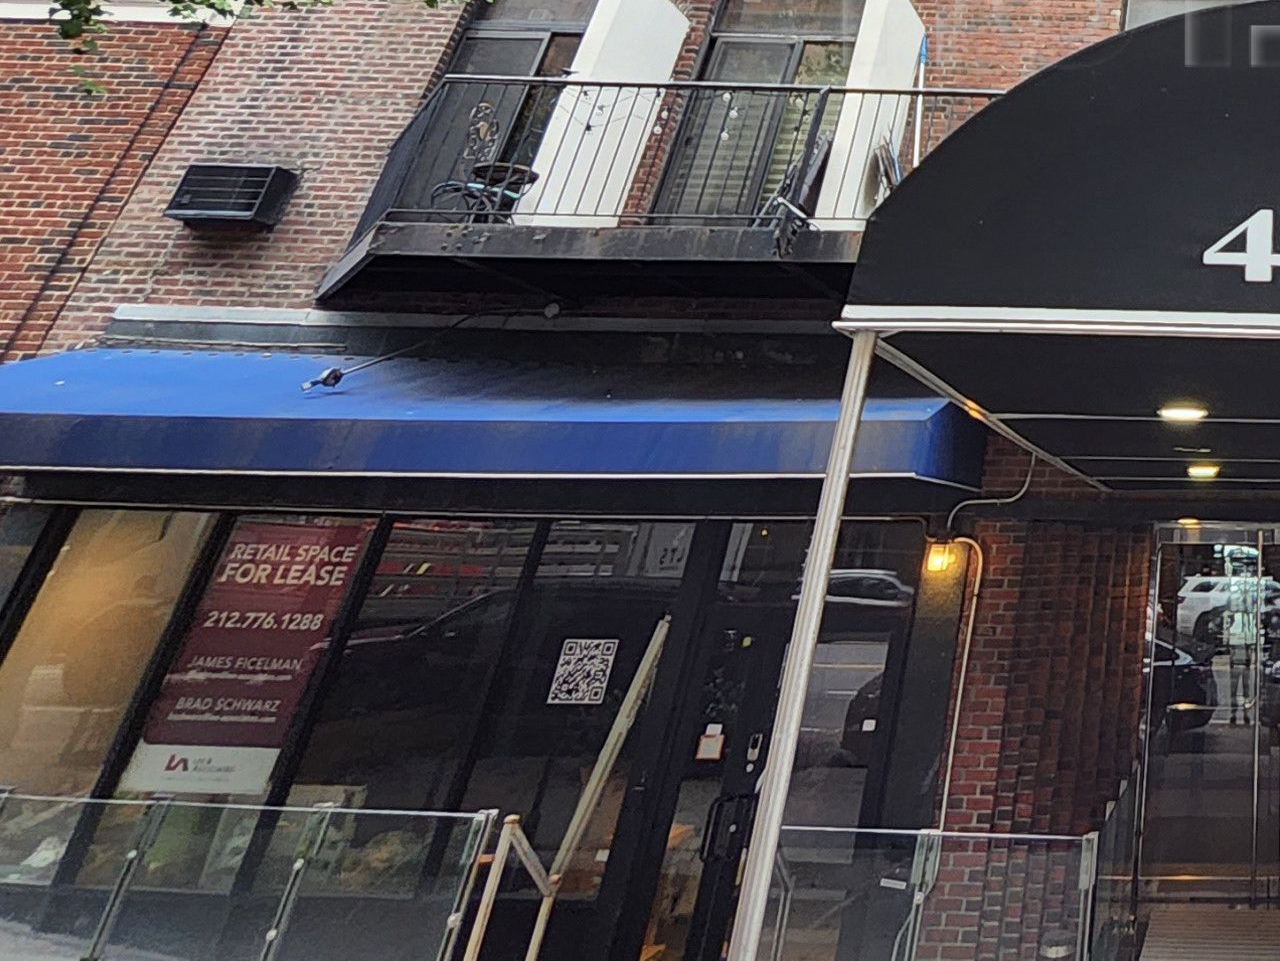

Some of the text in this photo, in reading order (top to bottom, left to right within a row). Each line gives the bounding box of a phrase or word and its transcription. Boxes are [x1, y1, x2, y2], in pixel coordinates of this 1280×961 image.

[229, 543, 358, 563] RETAIL SPACE
[218, 563, 349, 586] FOR LEASE
[203, 610, 325, 631] 212.776.1288
[187, 655, 234, 668] JAMES
[175, 697, 282, 712] BRAD SCHWARZ
